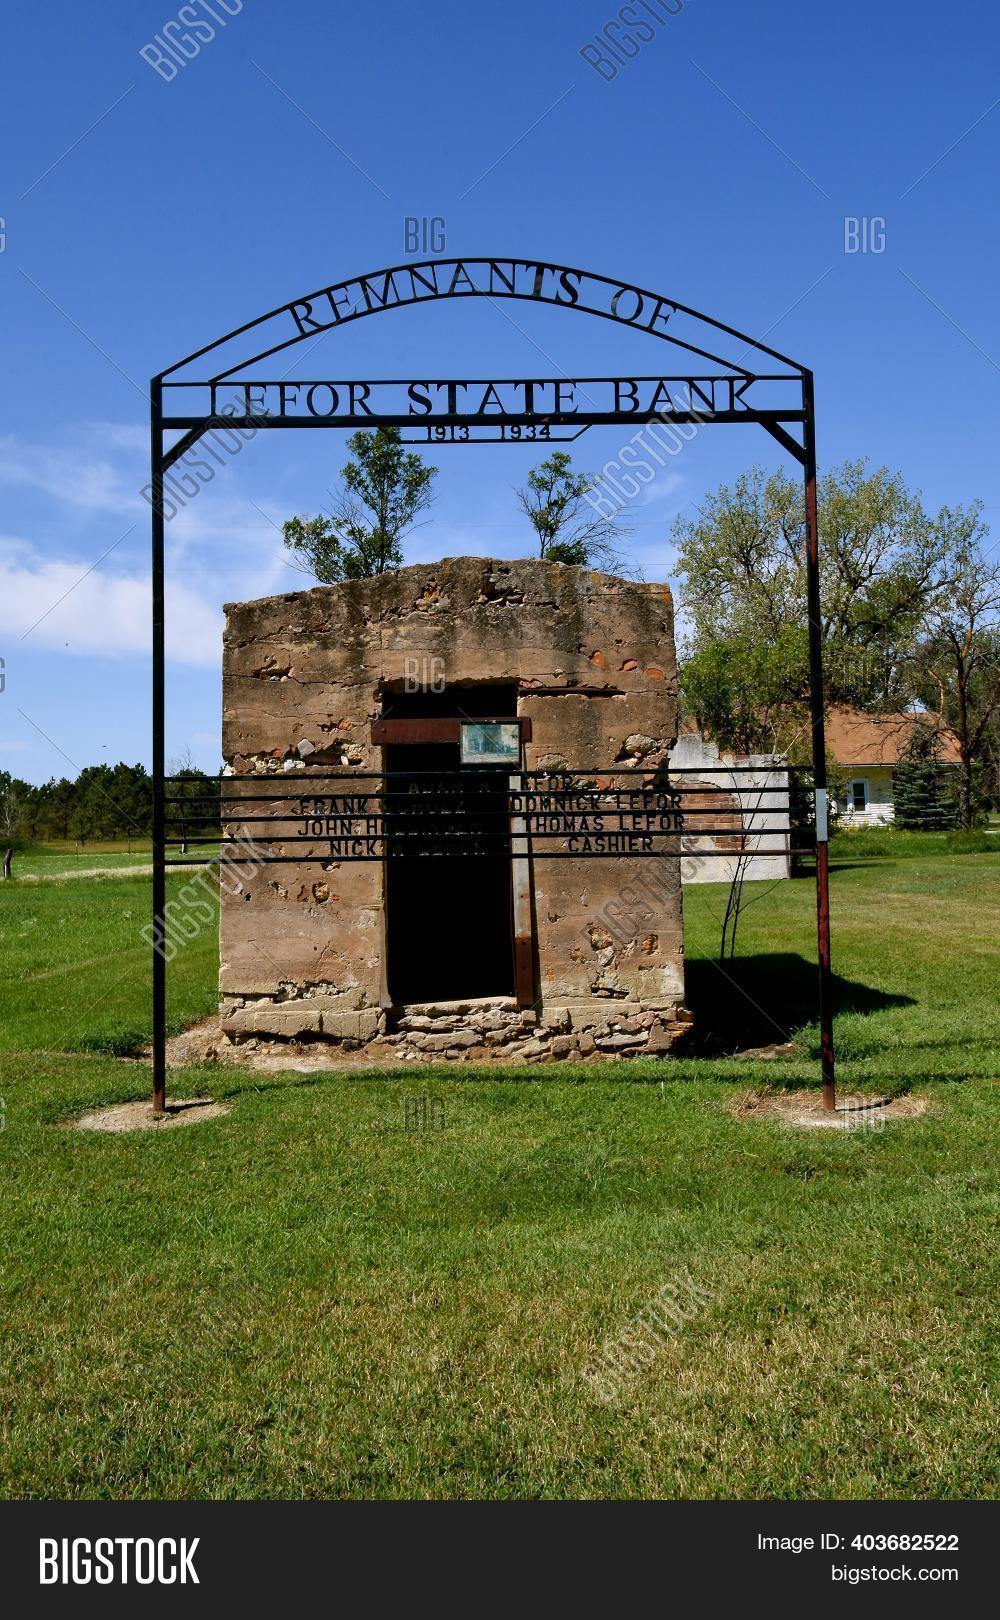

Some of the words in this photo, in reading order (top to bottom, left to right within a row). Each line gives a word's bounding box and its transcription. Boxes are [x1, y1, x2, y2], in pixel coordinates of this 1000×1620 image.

[287, 262, 582, 336] REMNANTS
[610, 287, 677, 330] OF
[208, 382, 376, 417] LEFOR
[408, 381, 579, 416] STATE
[612, 378, 758, 414] BANK
[426, 425, 470, 441] 1913
[500, 424, 551, 440] 1934
[300, 798, 368, 815] FRANK
[616, 794, 682, 811] LEFOR
[298, 818, 353, 836] JOHN
[522, 815, 604, 832] THOMAS
[619, 813, 685, 831] LEFOR
[330, 839, 378, 856] NICK
[568, 835, 653, 853] CASHIER
